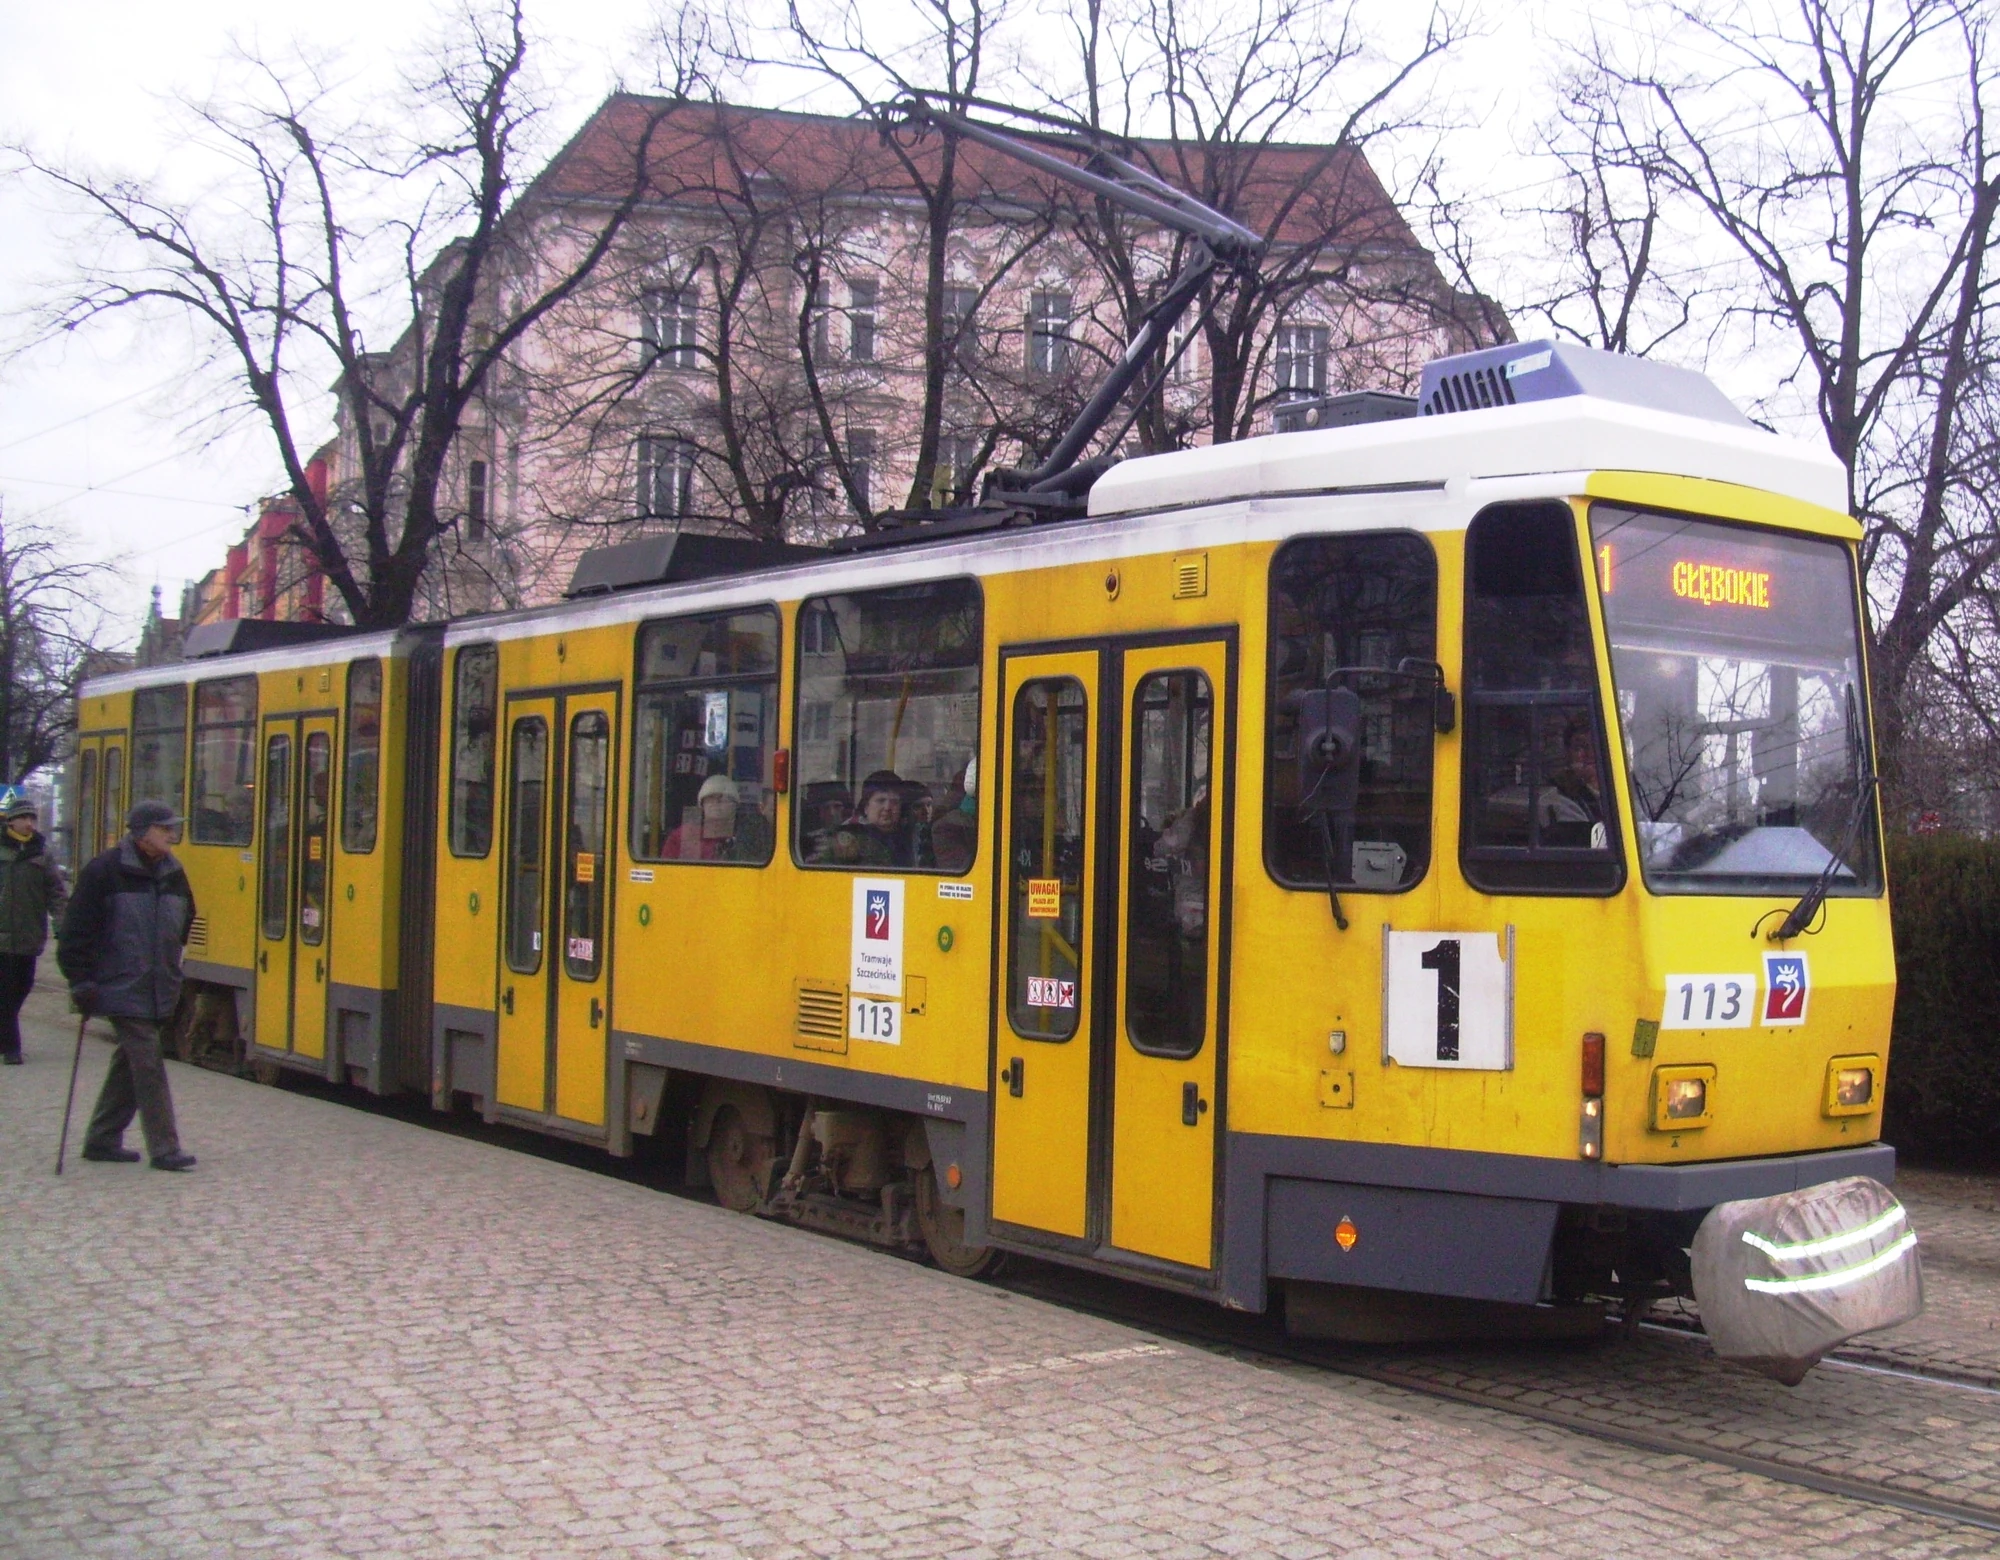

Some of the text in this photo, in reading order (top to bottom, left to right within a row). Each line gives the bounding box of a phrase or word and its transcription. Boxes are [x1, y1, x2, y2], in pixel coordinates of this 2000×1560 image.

[1599, 545, 1769, 609] 1 GŁĘBOKIE
[1030, 883, 1059, 895] UWAGA!
[856, 967, 897, 981] Szczecińskie
[861, 952, 892, 967] Tramwaje
[1421, 939, 1461, 1061] 1
[1680, 982, 1742, 1021] 113
[857, 1003, 893, 1038] 113
